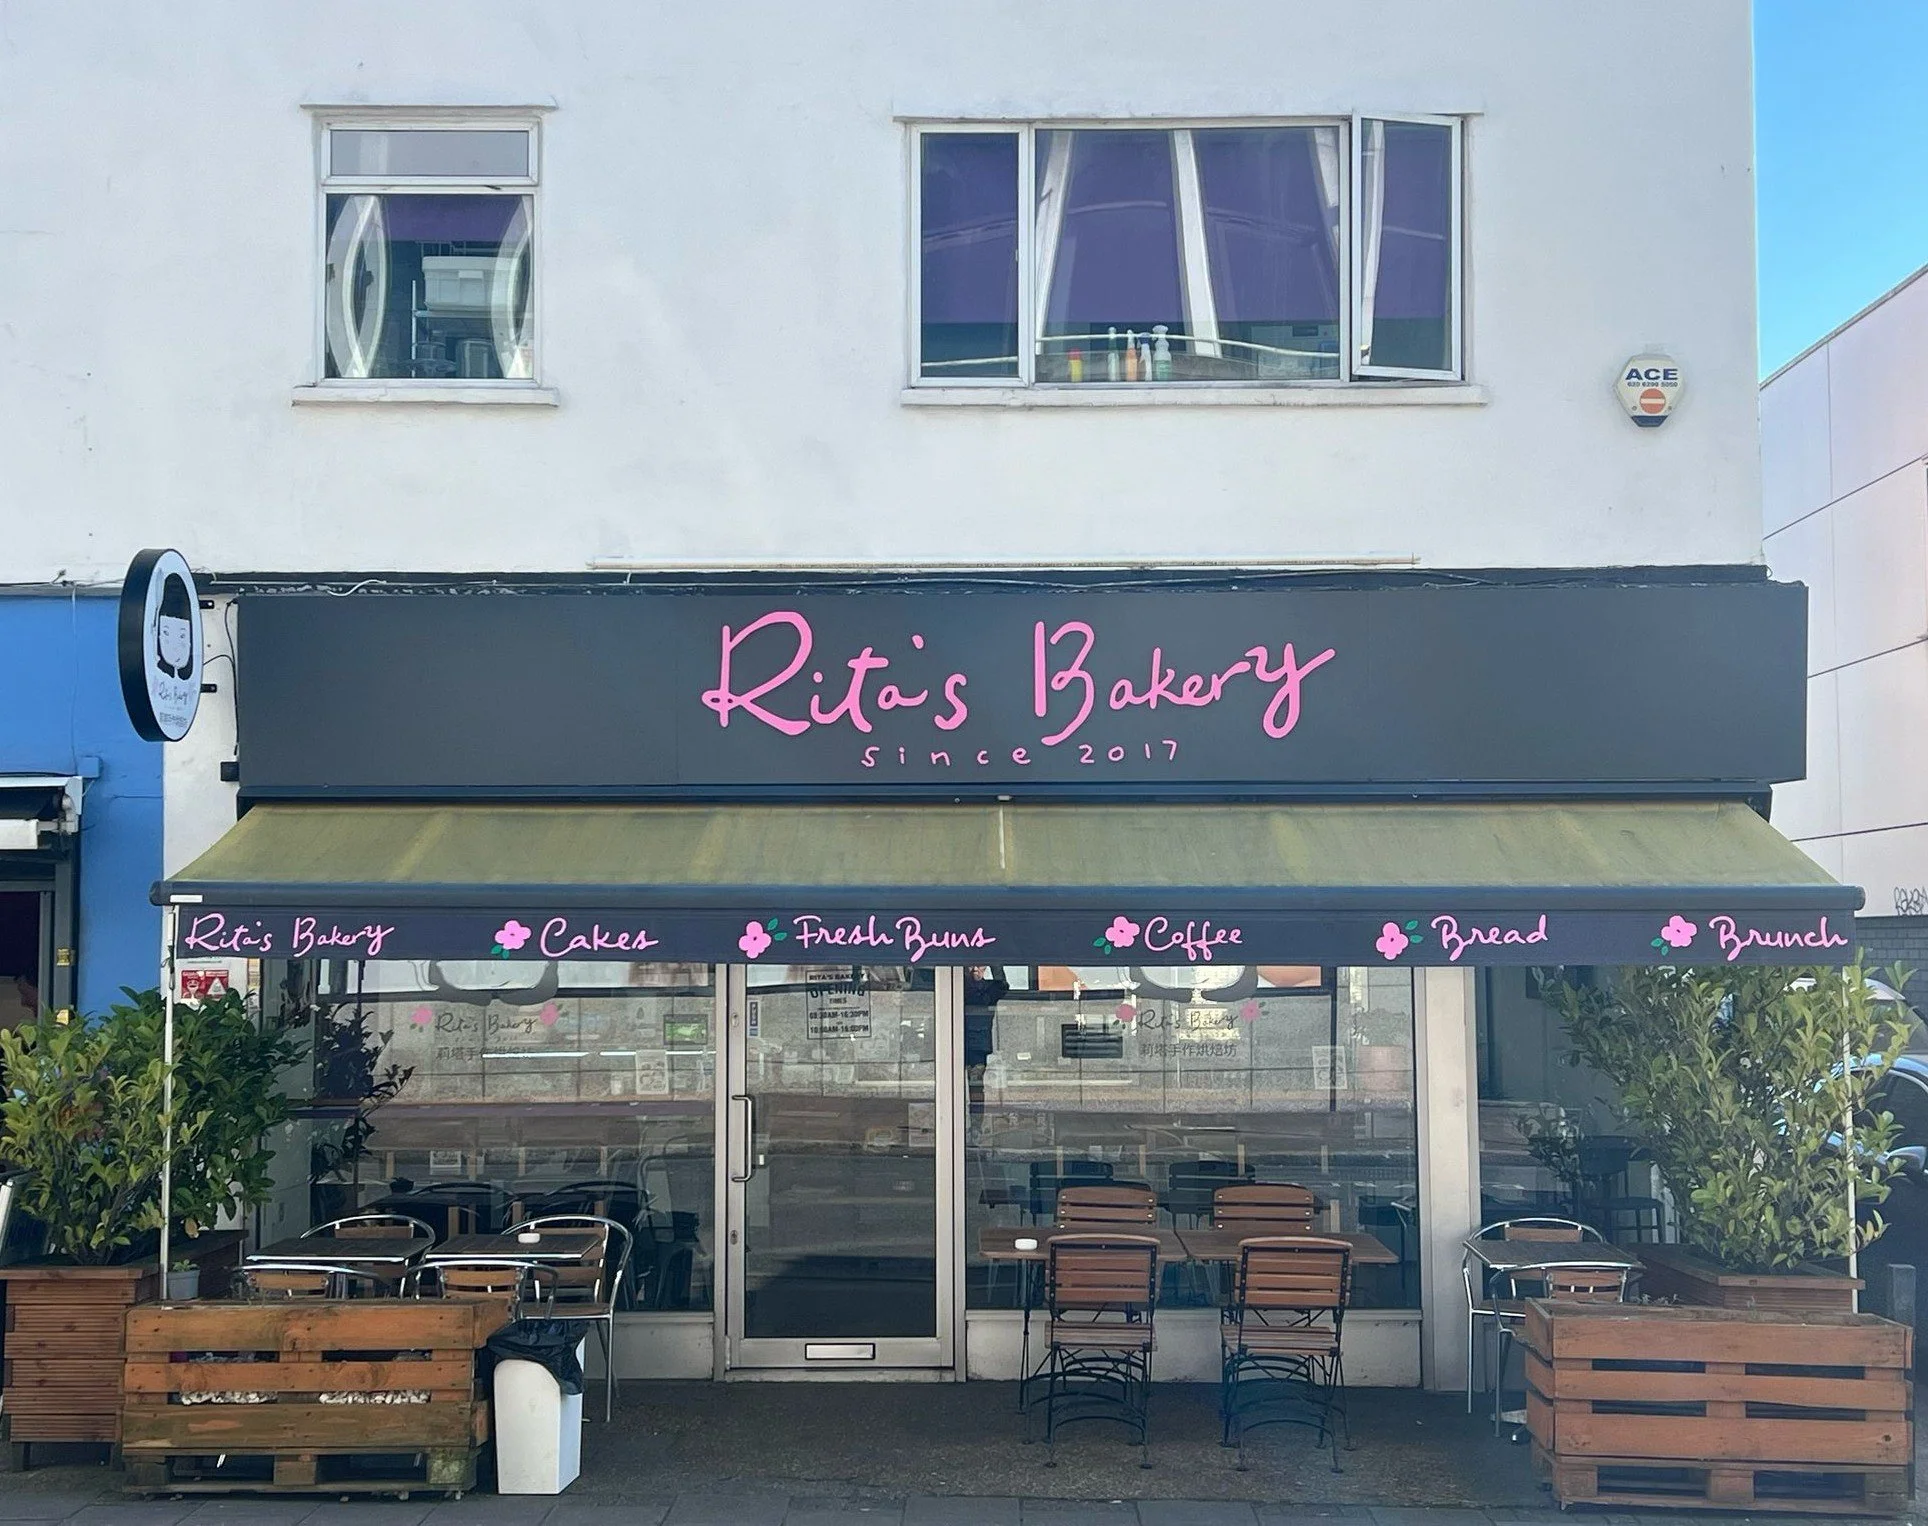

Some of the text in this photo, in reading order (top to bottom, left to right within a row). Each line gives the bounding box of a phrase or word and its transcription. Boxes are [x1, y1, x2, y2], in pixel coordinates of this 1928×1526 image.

[1625, 368, 1679, 380] ACE
[702, 611, 1336, 747] Rita's Bakery
[861, 740, 1180, 767] since 2017
[185, 912, 395, 956] Rita's Bakery
[540, 917, 660, 957] Cakes
[792, 915, 998, 961] Fresh Buns
[1144, 916, 1243, 960] Coffee
[1431, 914, 1549, 961] Bread
[1709, 915, 1848, 961] Brunch
